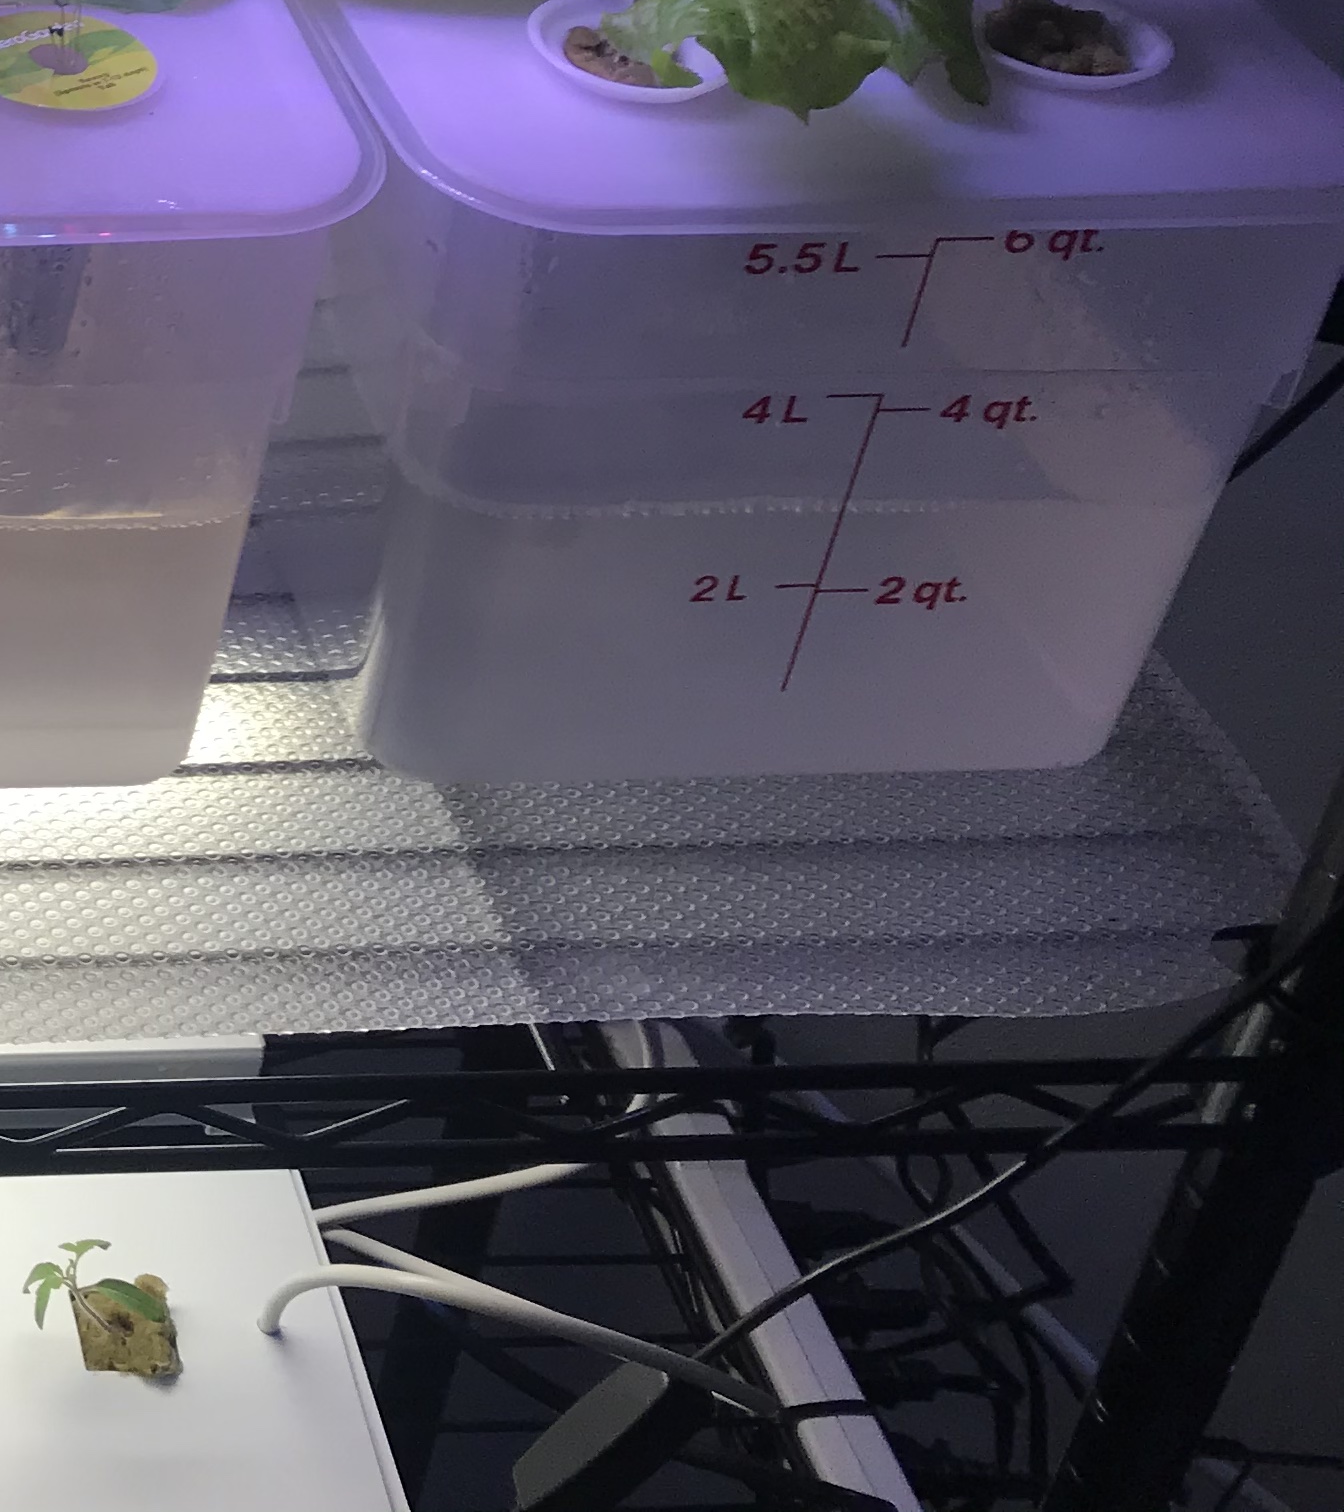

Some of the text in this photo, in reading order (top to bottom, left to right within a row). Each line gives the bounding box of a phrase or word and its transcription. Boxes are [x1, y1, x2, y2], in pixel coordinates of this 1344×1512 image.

[745, 242, 859, 274] 5.5 L
[742, 396, 807, 424] 4 L
[941, 395, 1038, 429] 4 qt.
[690, 575, 748, 603] 2 L
[874, 576, 906, 605] 2
